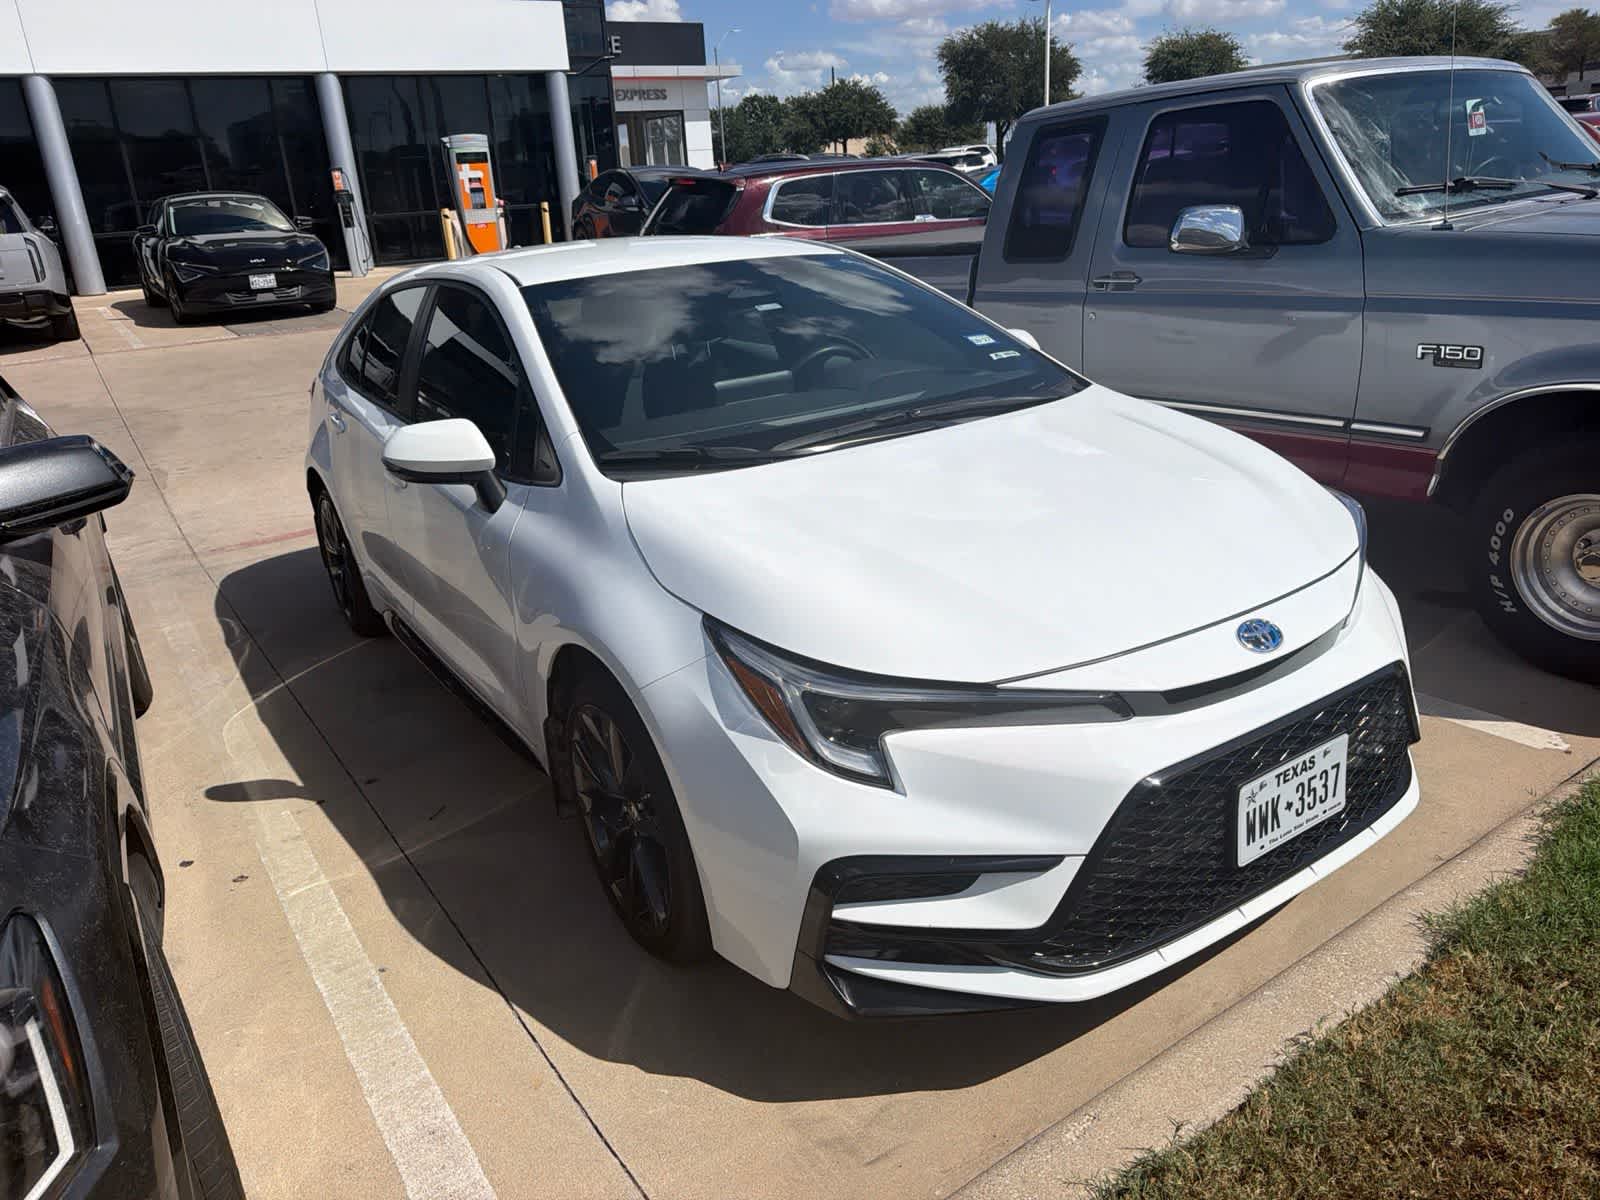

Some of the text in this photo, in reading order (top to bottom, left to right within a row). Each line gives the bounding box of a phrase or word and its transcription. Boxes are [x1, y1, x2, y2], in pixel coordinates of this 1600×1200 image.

[608, 34, 622, 54] E
[614, 88, 667, 101] EXPRESS
[1488, 508, 1514, 566] 4000
[1274, 754, 1317, 788] TEXAS
[1295, 761, 1341, 818] 3537
